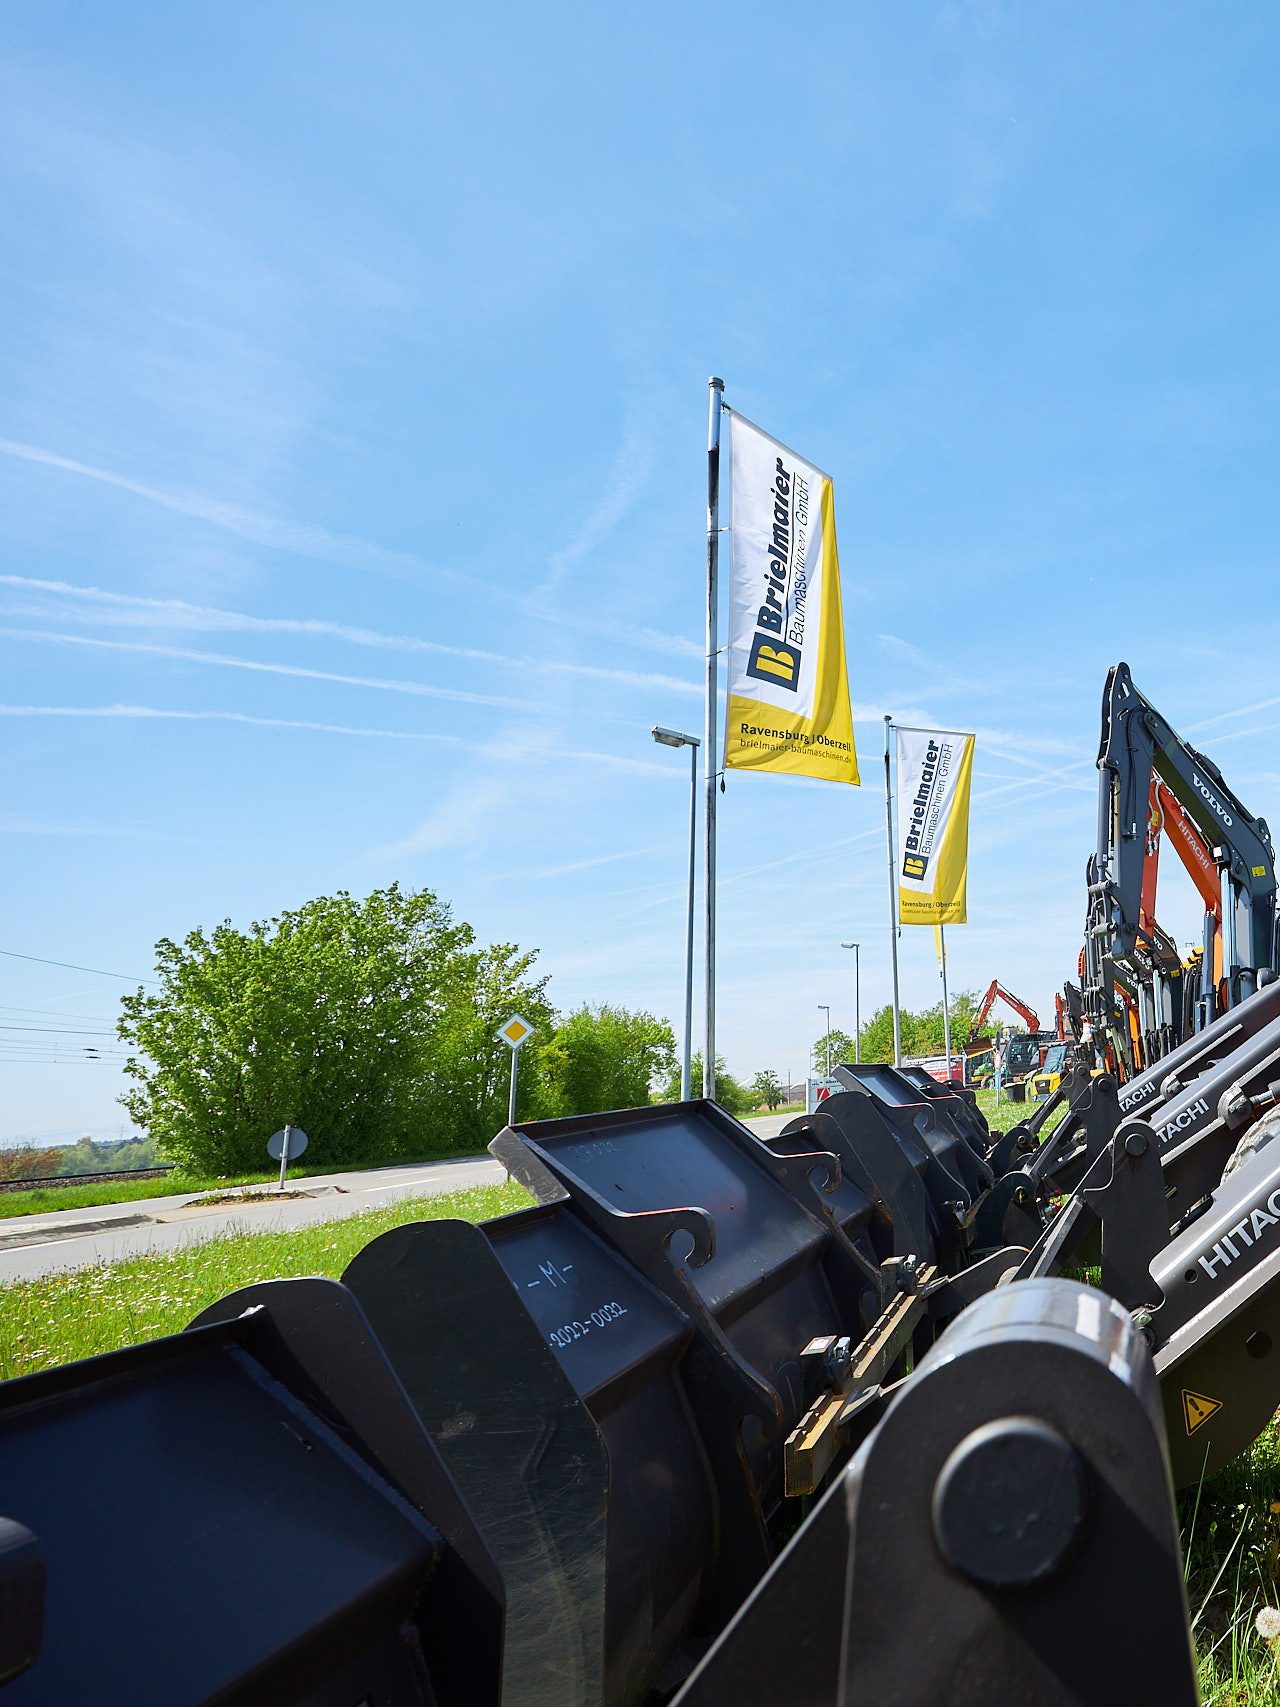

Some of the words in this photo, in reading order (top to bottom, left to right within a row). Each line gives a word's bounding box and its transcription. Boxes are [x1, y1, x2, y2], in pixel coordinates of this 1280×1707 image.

[795, 475, 809, 526] GmbH
[756, 457, 791, 635] Brielmaier
[789, 529, 807, 646] Baumaschinen
[740, 738, 852, 763] brielmaier-baumaschinen.de
[741, 723, 810, 745] Ravensburg
[816, 734, 852, 753] Oberzell
[905, 739, 940, 851] Brielmaier
[921, 781, 946, 854] Baumaschinen
[938, 743, 954, 778] GmbH
[1192, 772, 1233, 827] VOLVO
[1178, 820, 1210, 869] HITACHI
